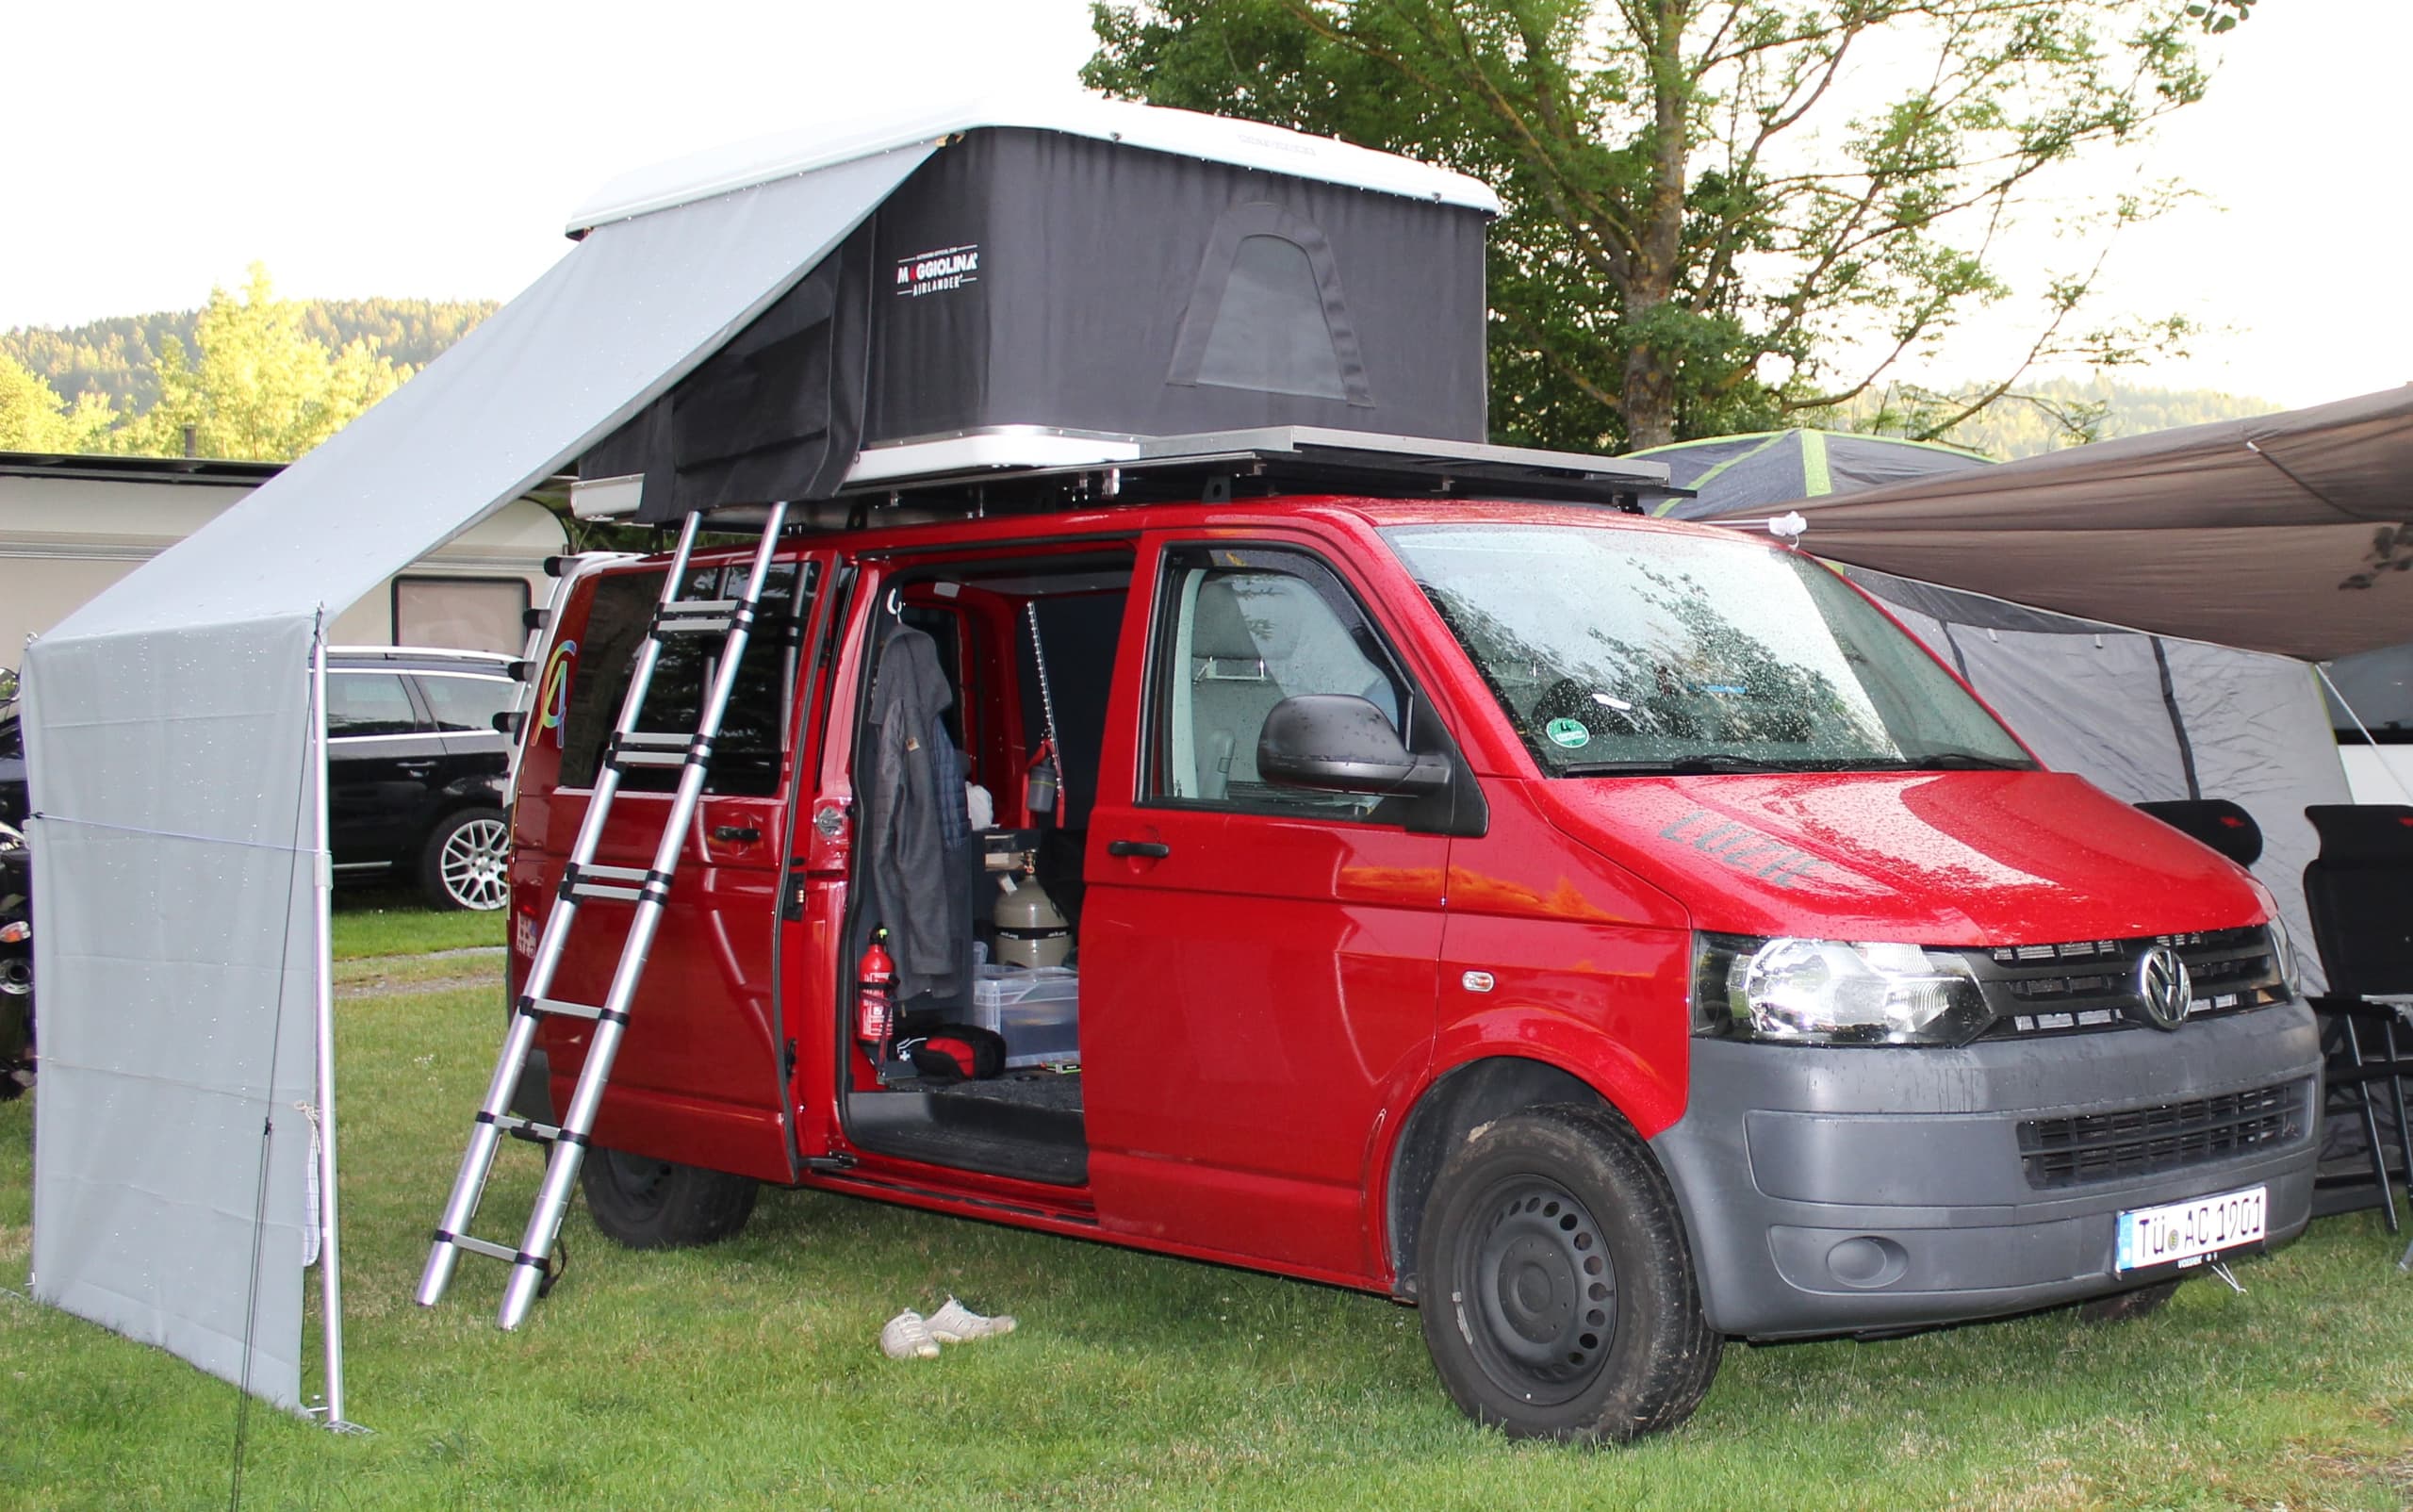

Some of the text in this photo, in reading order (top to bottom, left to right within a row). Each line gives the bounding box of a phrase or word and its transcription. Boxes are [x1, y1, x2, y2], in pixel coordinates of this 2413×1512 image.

[2139, 1195, 2260, 1258] TÜ AC 1901
